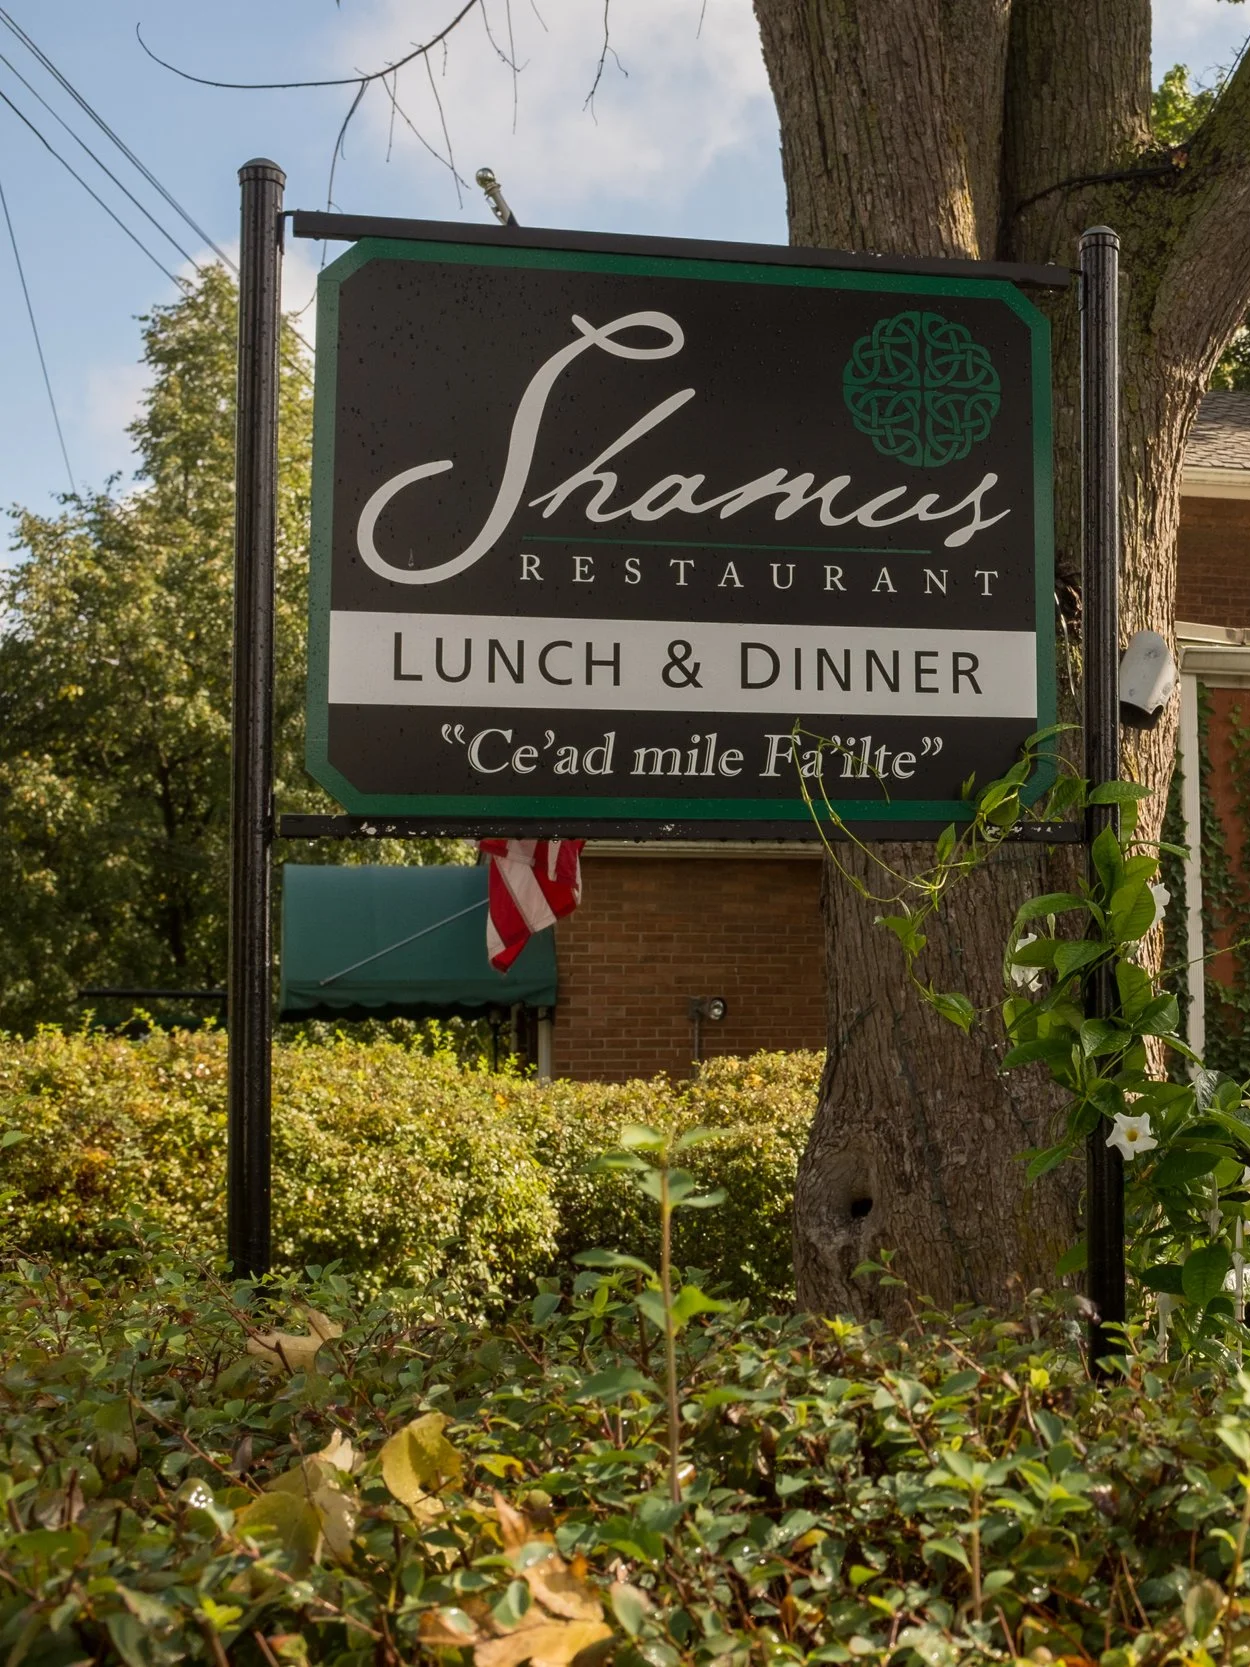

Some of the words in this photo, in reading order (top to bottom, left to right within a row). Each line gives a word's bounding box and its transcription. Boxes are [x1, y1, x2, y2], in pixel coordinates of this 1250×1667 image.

[357, 311, 1011, 584] Shamus
[519, 553, 1000, 597] RESTAURANT
[392, 631, 622, 687] LUNCH
[660, 639, 704, 689] &
[740, 642, 984, 695] DINNER
[630, 732, 744, 777] mile
